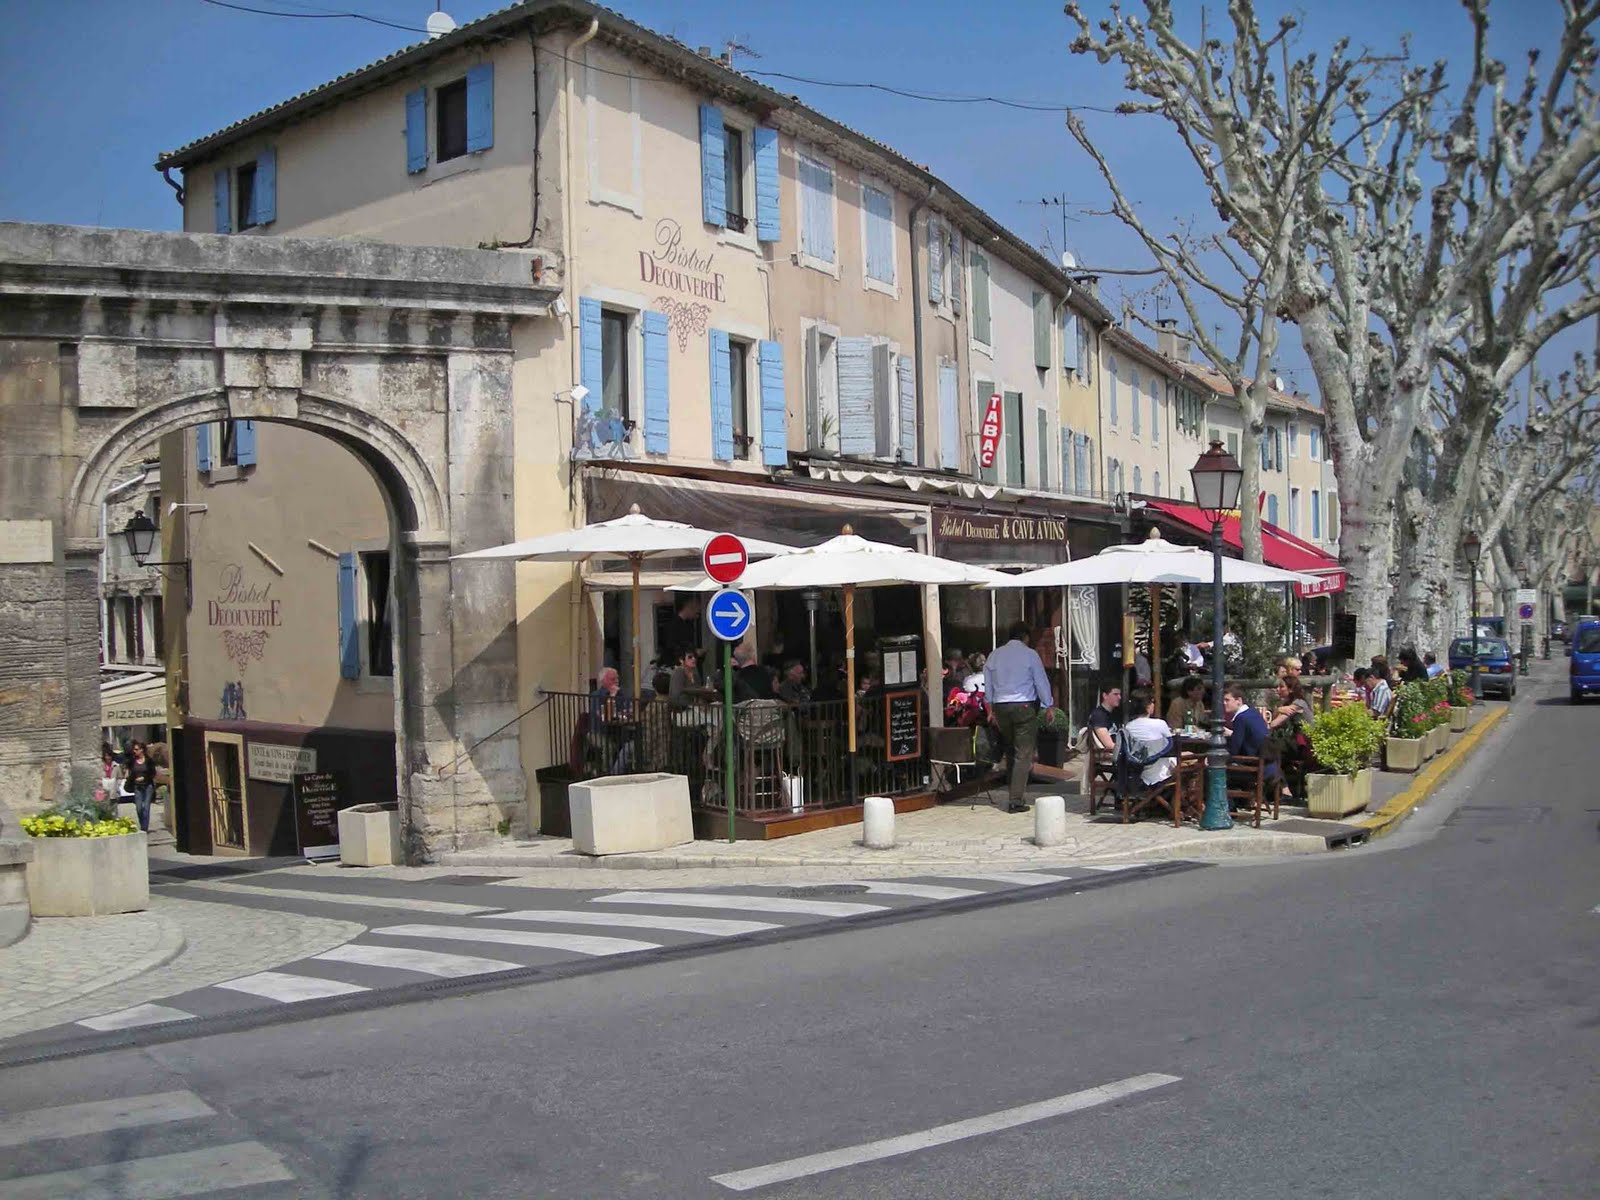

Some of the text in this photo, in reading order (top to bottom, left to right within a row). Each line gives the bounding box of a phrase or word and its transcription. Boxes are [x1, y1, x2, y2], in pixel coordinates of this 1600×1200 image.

[652, 218, 714, 273] Bistrot
[638, 250, 726, 303] DECOUVERTE
[981, 396, 1000, 464] TABAC
[966, 521, 1000, 539] DECOUVERTE
[1002, 518, 1010, 539] &
[1012, 518, 1035, 540] CAVE
[1043, 520, 1065, 541] VINS
[208, 599, 282, 627] DECOUVERTE
[107, 709, 162, 719] PIZZERIA
